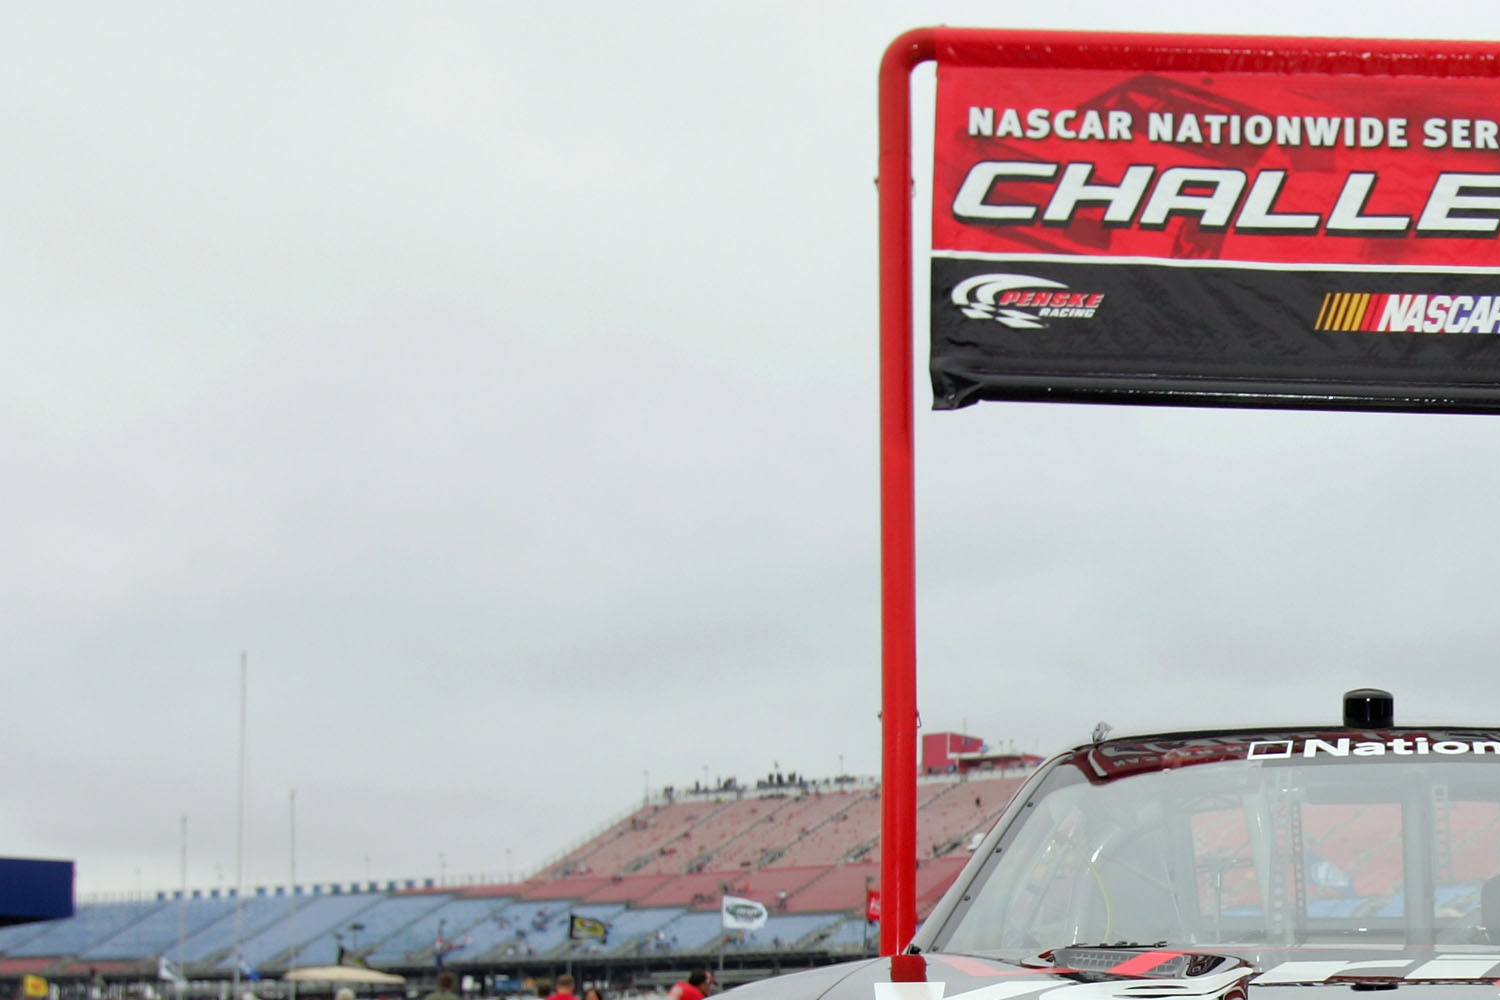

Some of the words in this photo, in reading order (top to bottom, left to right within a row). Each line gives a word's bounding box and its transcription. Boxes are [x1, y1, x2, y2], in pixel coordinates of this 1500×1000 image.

[968, 106, 1133, 141] NASCAR
[1148, 112, 1409, 149] NATIONWIDE
[998, 290, 1105, 308] PENSKE
[1038, 307, 1096, 319] RACING
